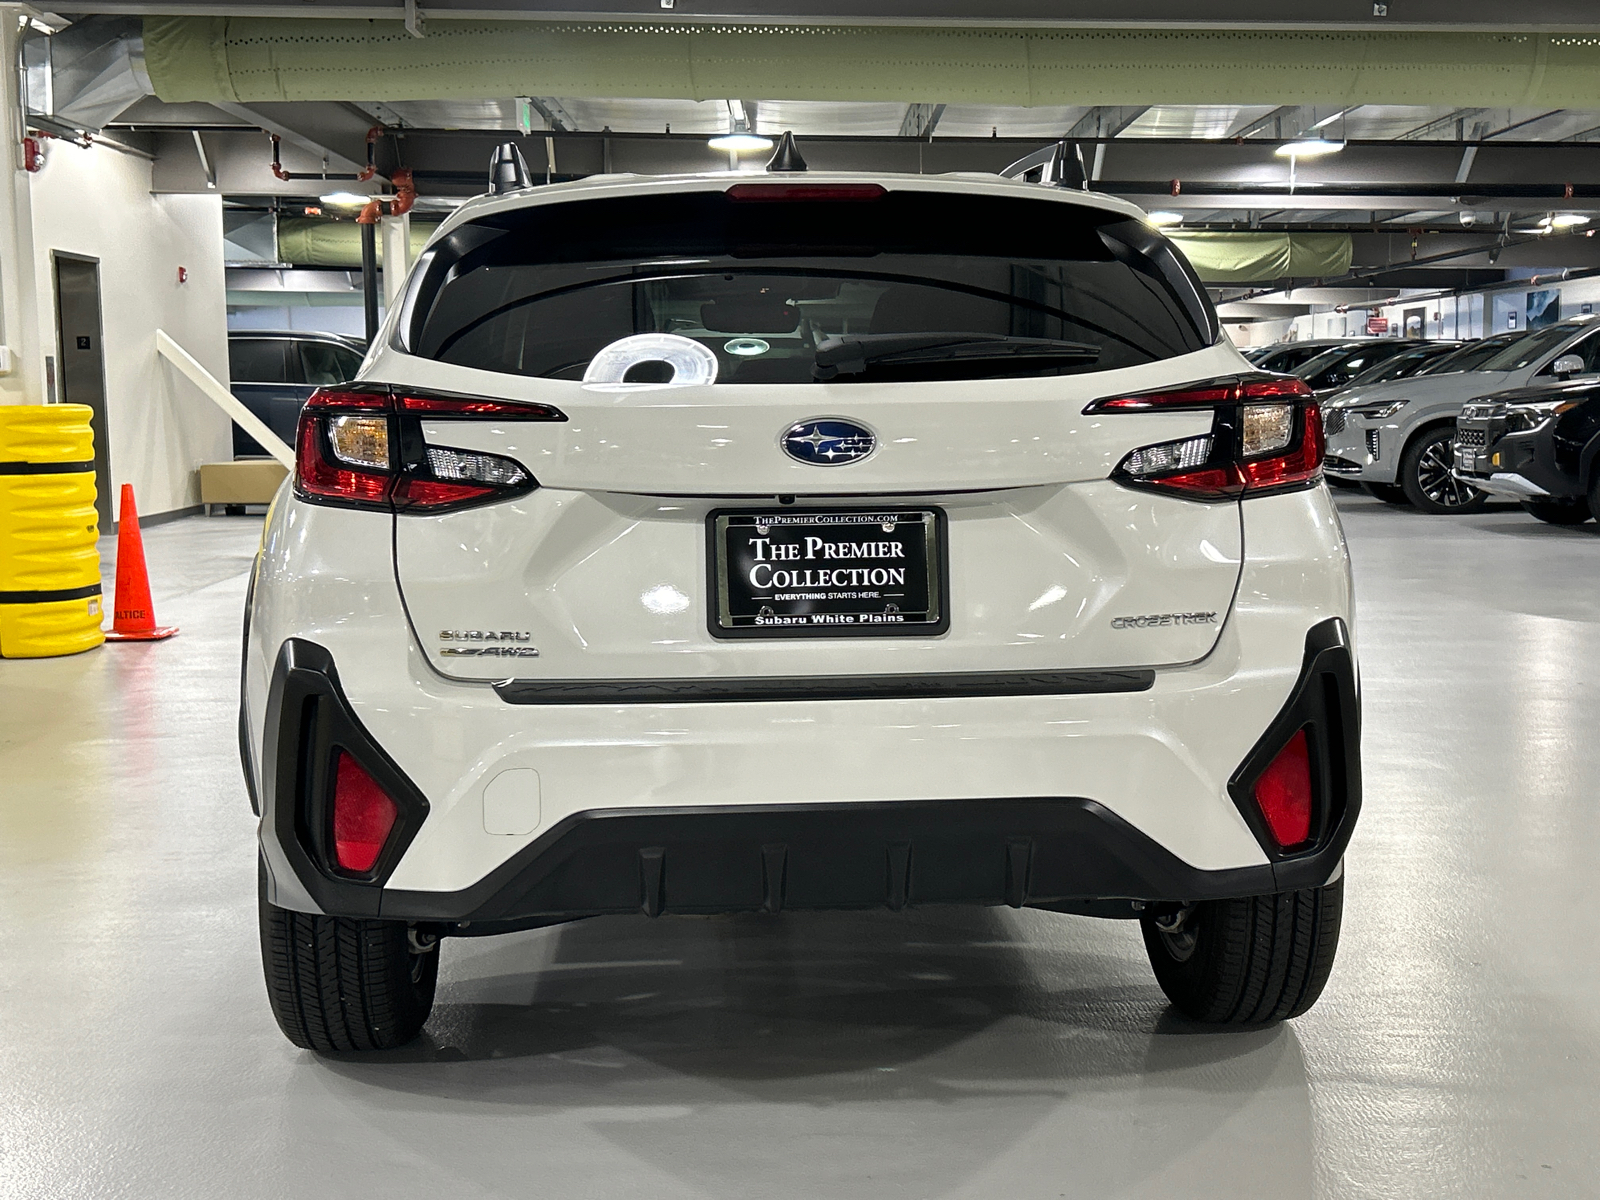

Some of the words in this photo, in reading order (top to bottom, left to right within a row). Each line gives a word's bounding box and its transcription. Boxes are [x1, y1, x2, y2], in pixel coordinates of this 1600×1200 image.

[754, 515, 899, 525] THEPREMIERCOLLECTION.COM
[749, 538, 800, 561] THE
[804, 537, 905, 560] PREMIER
[749, 563, 905, 588] COLLECTION
[755, 616, 807, 625] Subaru
[811, 615, 854, 623] White
[860, 614, 904, 622] Plains
[1111, 612, 1217, 629] CROSSTREK
[440, 630, 530, 642] SUBARU
